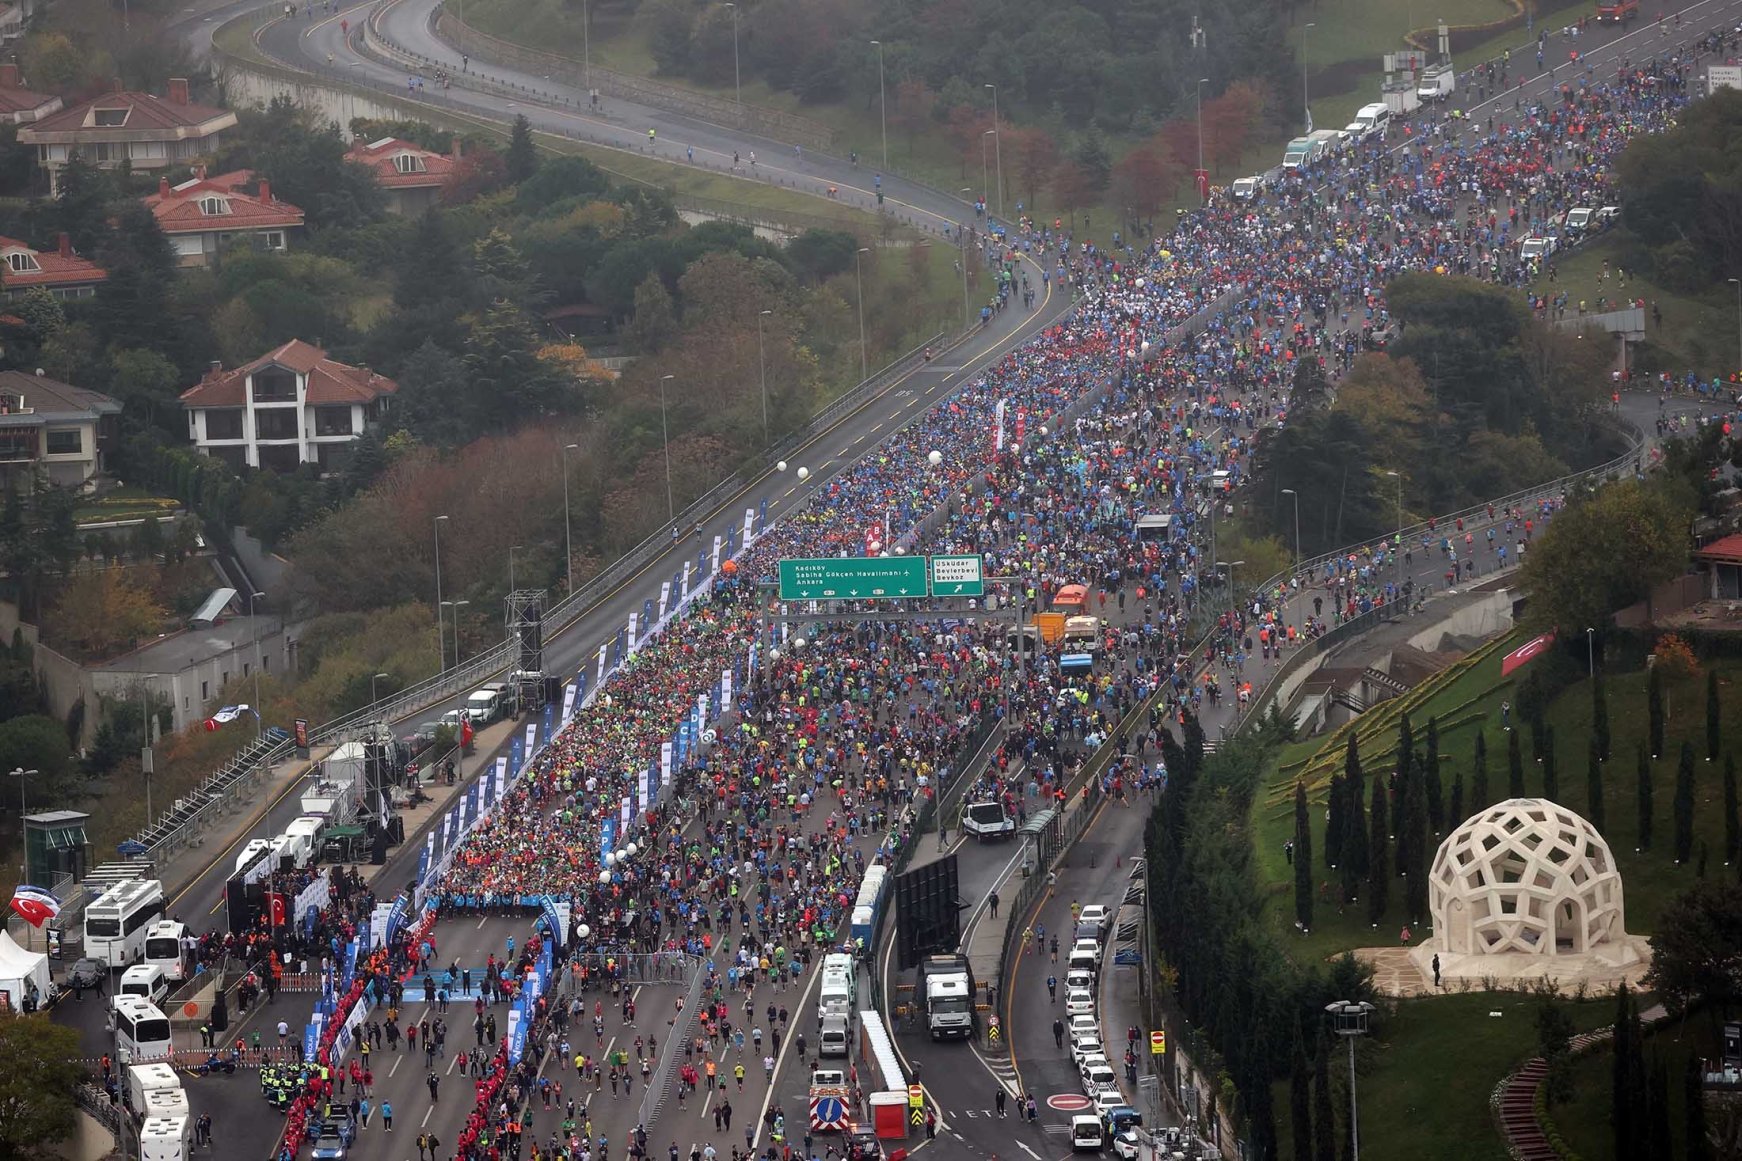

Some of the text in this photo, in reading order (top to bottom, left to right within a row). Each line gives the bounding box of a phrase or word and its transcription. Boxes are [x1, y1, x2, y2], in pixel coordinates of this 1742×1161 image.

[691, 714, 698, 722] D
[390, 900, 404, 919] START
[542, 899, 556, 917] START
